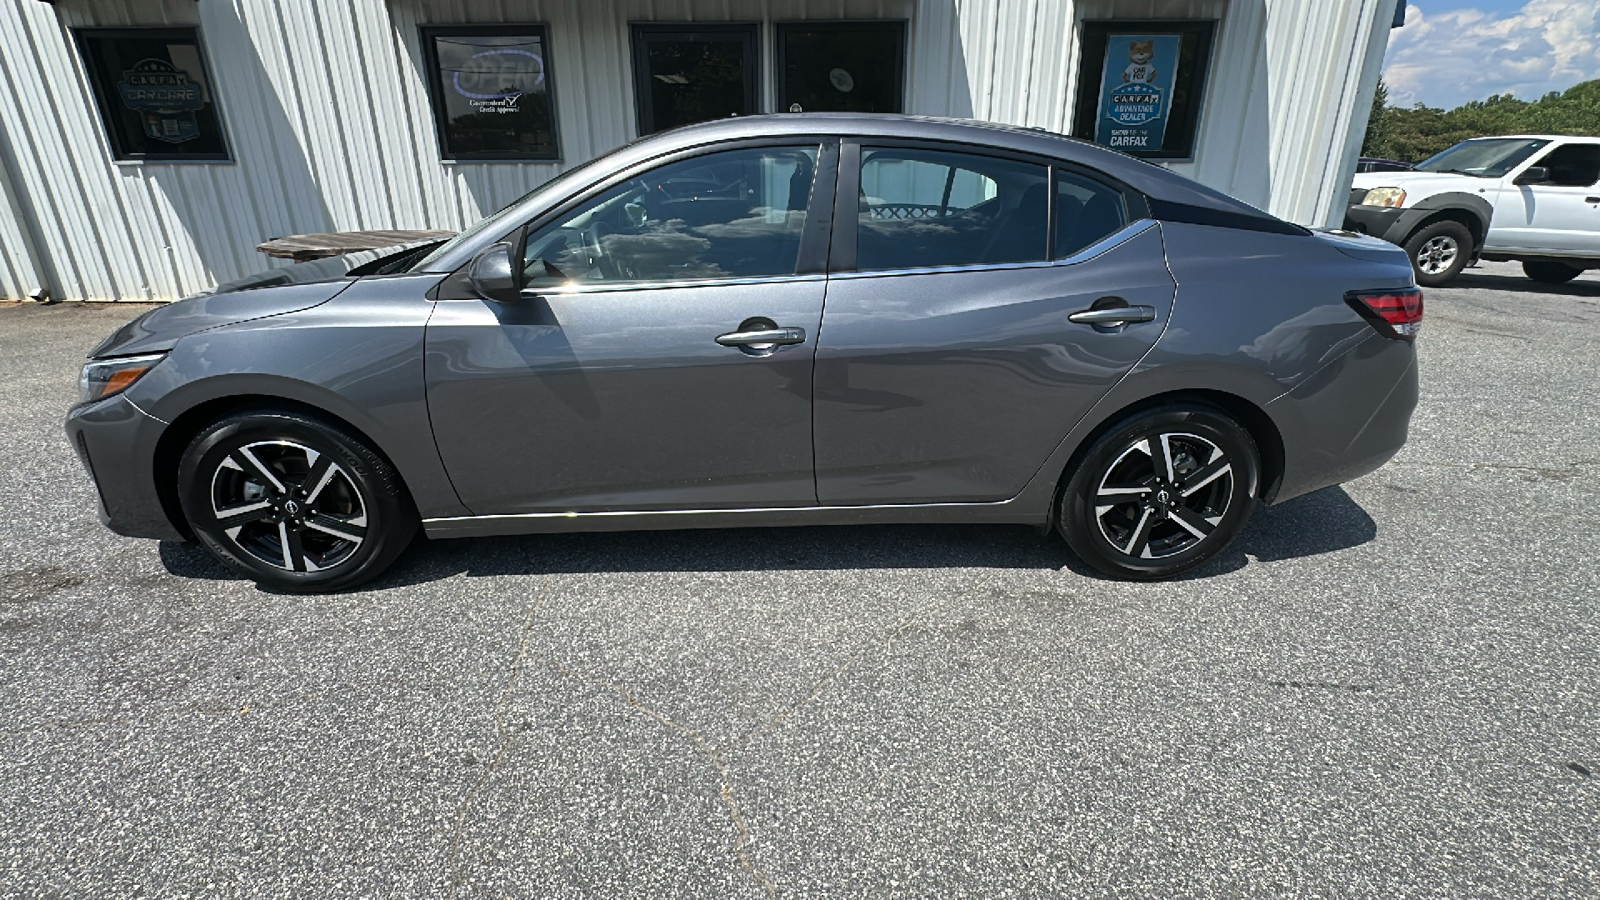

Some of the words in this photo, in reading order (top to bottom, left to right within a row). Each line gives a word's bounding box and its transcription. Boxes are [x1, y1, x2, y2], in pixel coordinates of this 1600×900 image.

[459, 58, 537, 90] OPEN
[130, 76, 187, 86] CARFAX
[127, 89, 156, 100] CAR
[157, 89, 195, 100] CARE
[1113, 94, 1159, 104] CARFAX
[1114, 104, 1154, 113] ADVANTAGE
[1120, 112, 1146, 121] DEALER
[1110, 136, 1148, 146] CARFAX
